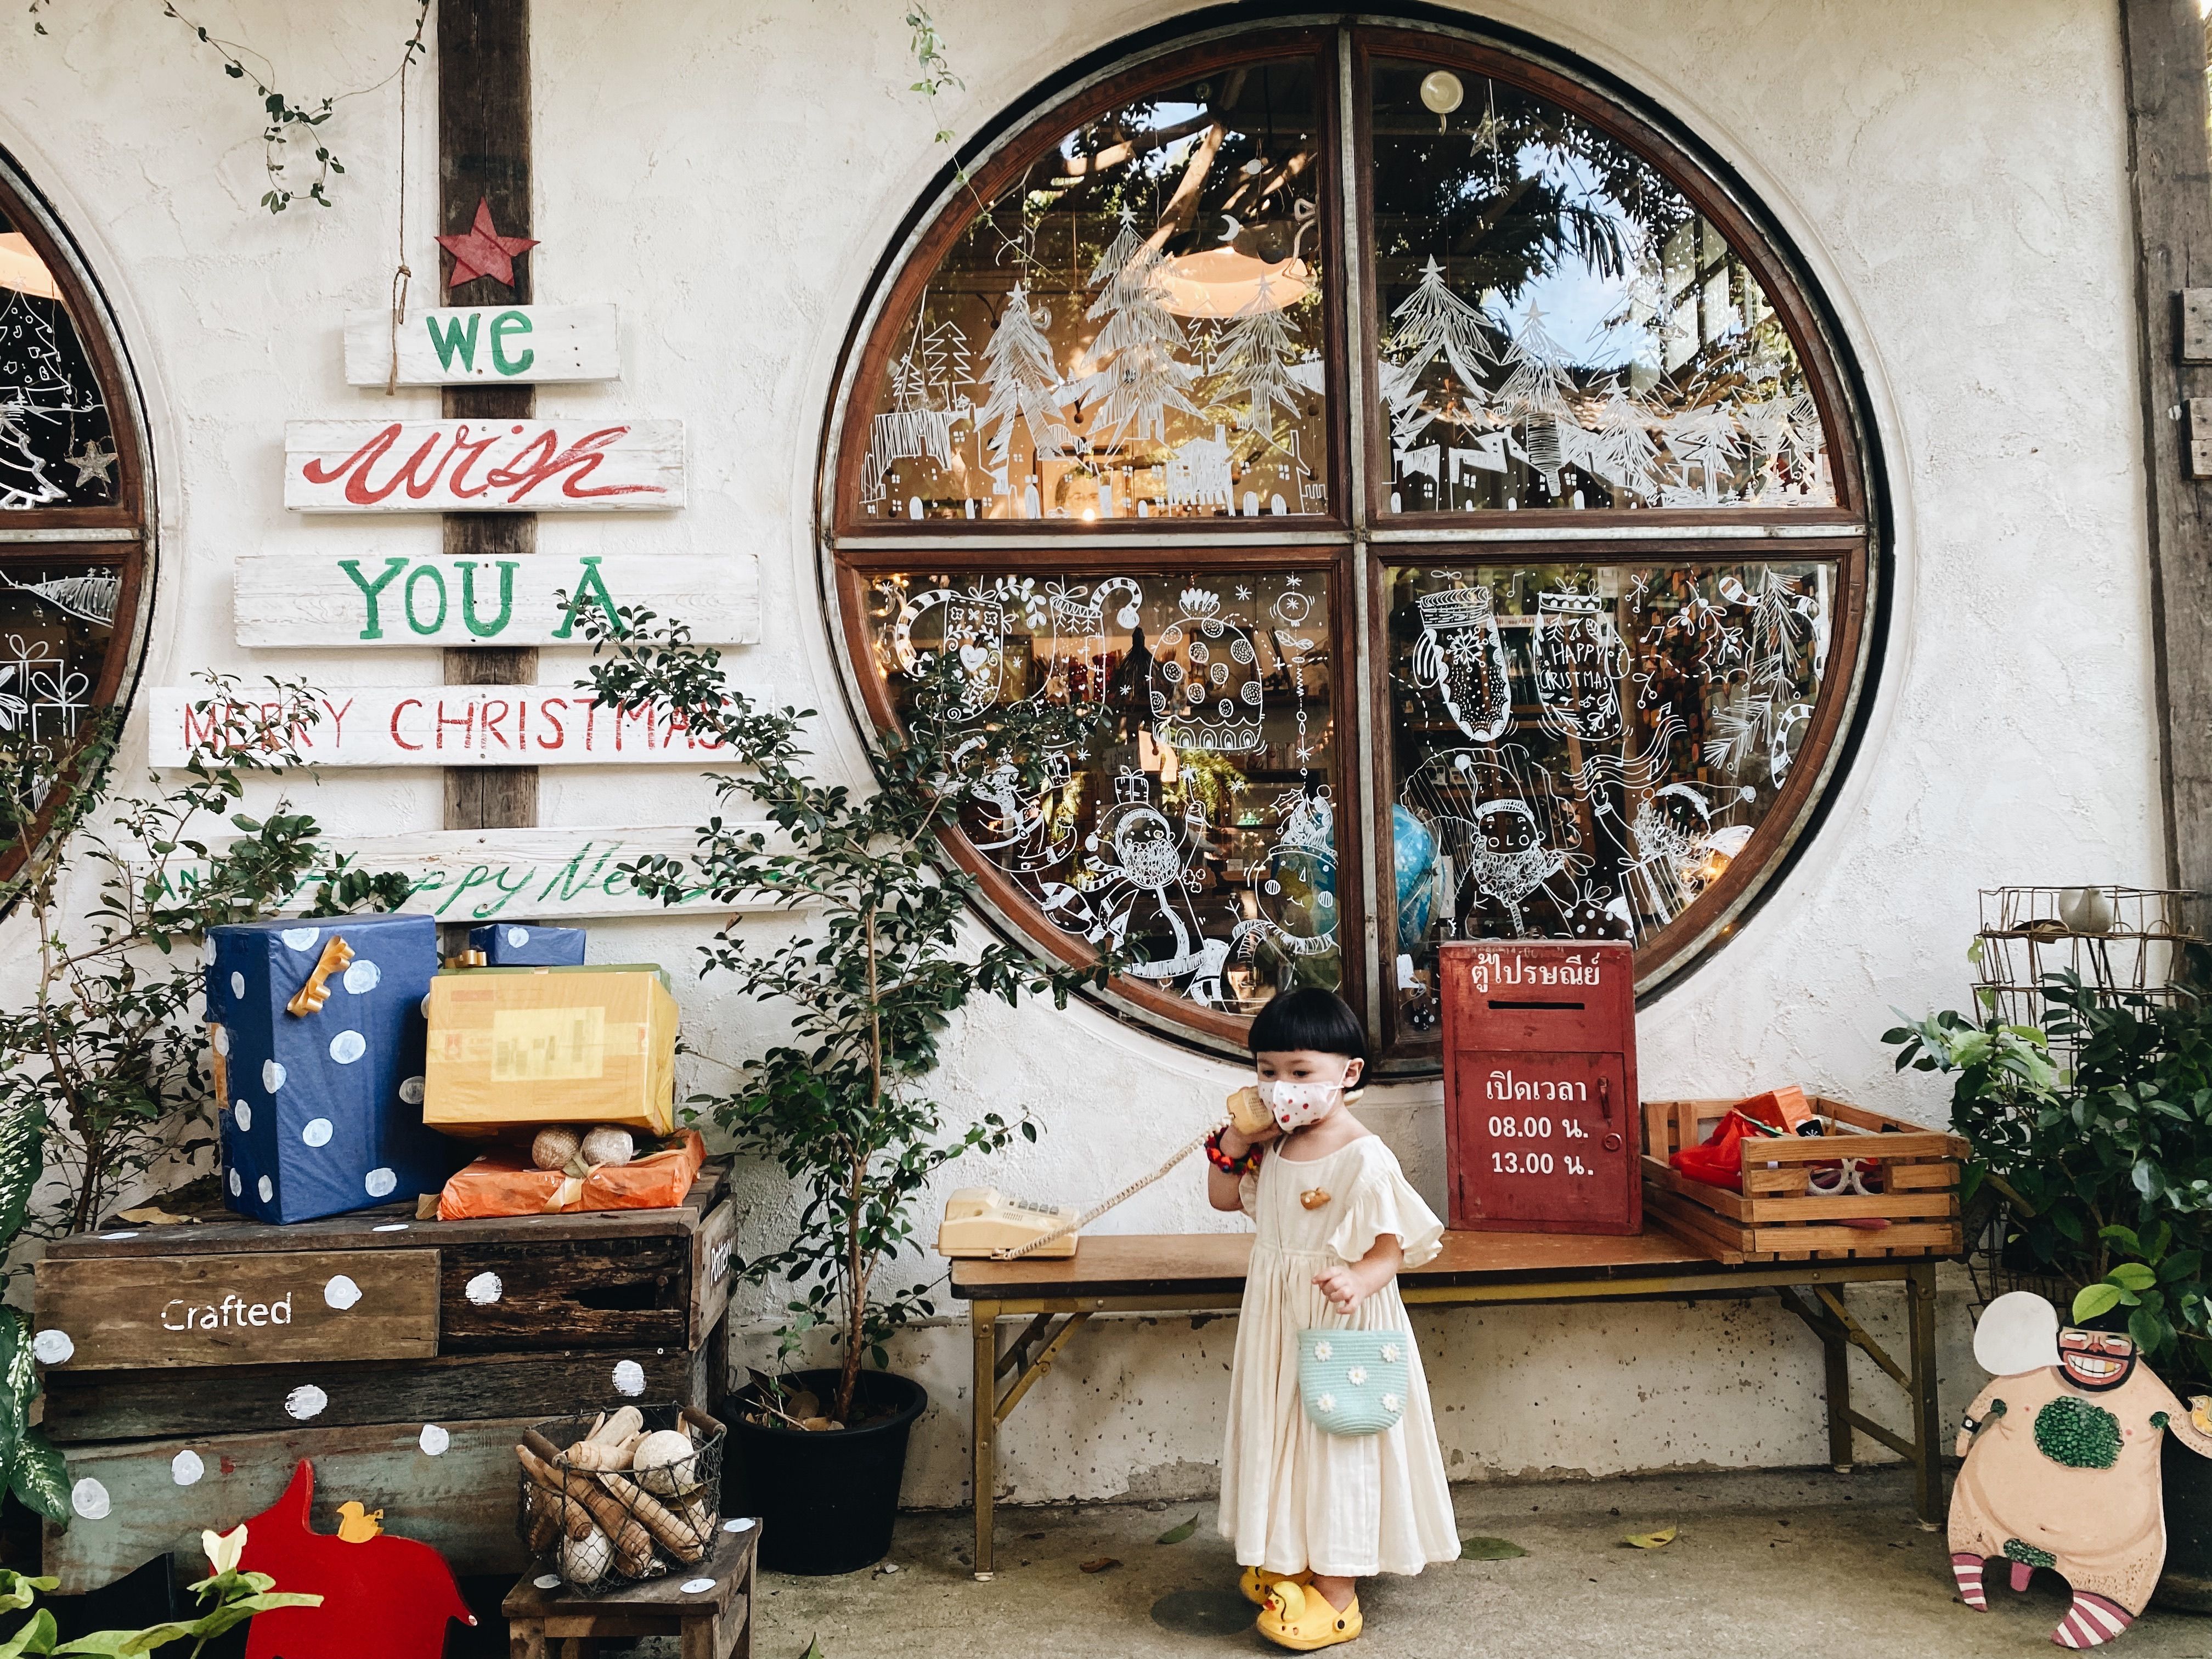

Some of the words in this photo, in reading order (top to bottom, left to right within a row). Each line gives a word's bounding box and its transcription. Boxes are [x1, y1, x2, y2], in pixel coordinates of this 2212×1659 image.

[337, 556, 520, 640] YOU
[550, 556, 629, 639] A
[1551, 642, 1605, 665] HAPPY
[184, 697, 353, 751] MERRY
[275, 841, 537, 919] Hppy
[1471, 952, 1601, 994] ตู้ไปรษณีย์
[1486, 1069, 1587, 1101] เปิดเวลา
[1488, 1116, 1552, 1138] 08.00
[1562, 1119, 1589, 1138] น.
[1492, 1152, 1554, 1173] 13.00
[1564, 1155, 1594, 1176] น.
[161, 1291, 292, 1331] Crafted
